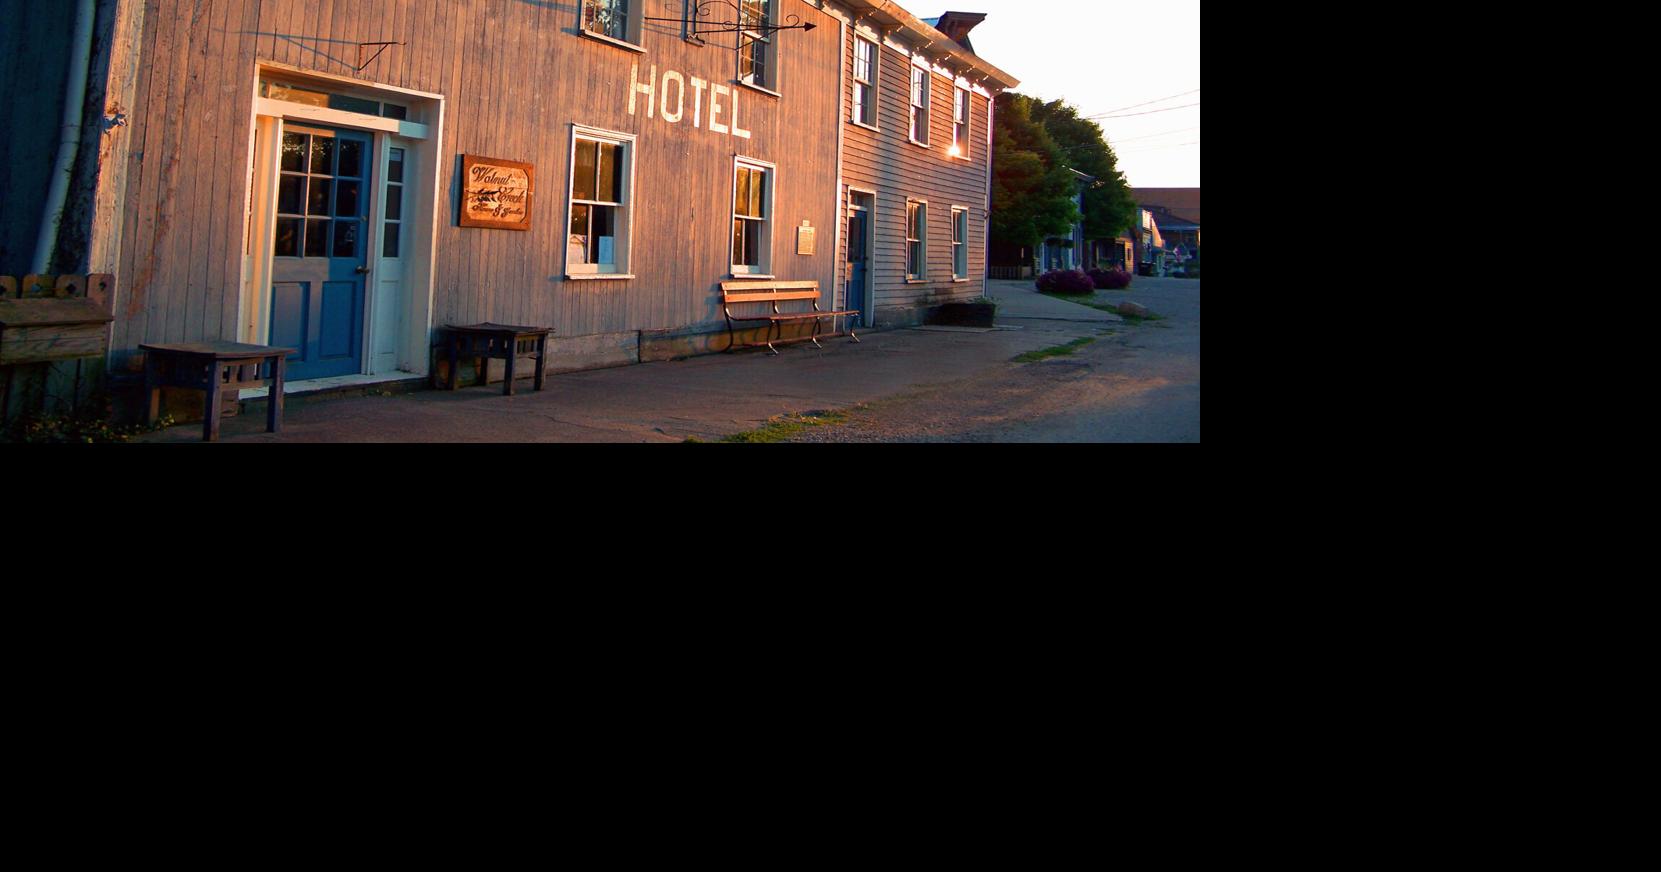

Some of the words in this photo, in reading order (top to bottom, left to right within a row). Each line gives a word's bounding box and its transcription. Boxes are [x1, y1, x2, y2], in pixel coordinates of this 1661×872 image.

[628, 64, 751, 139] HOTEL
[472, 166, 513, 185] Walnut
[498, 186, 525, 203] Creek
